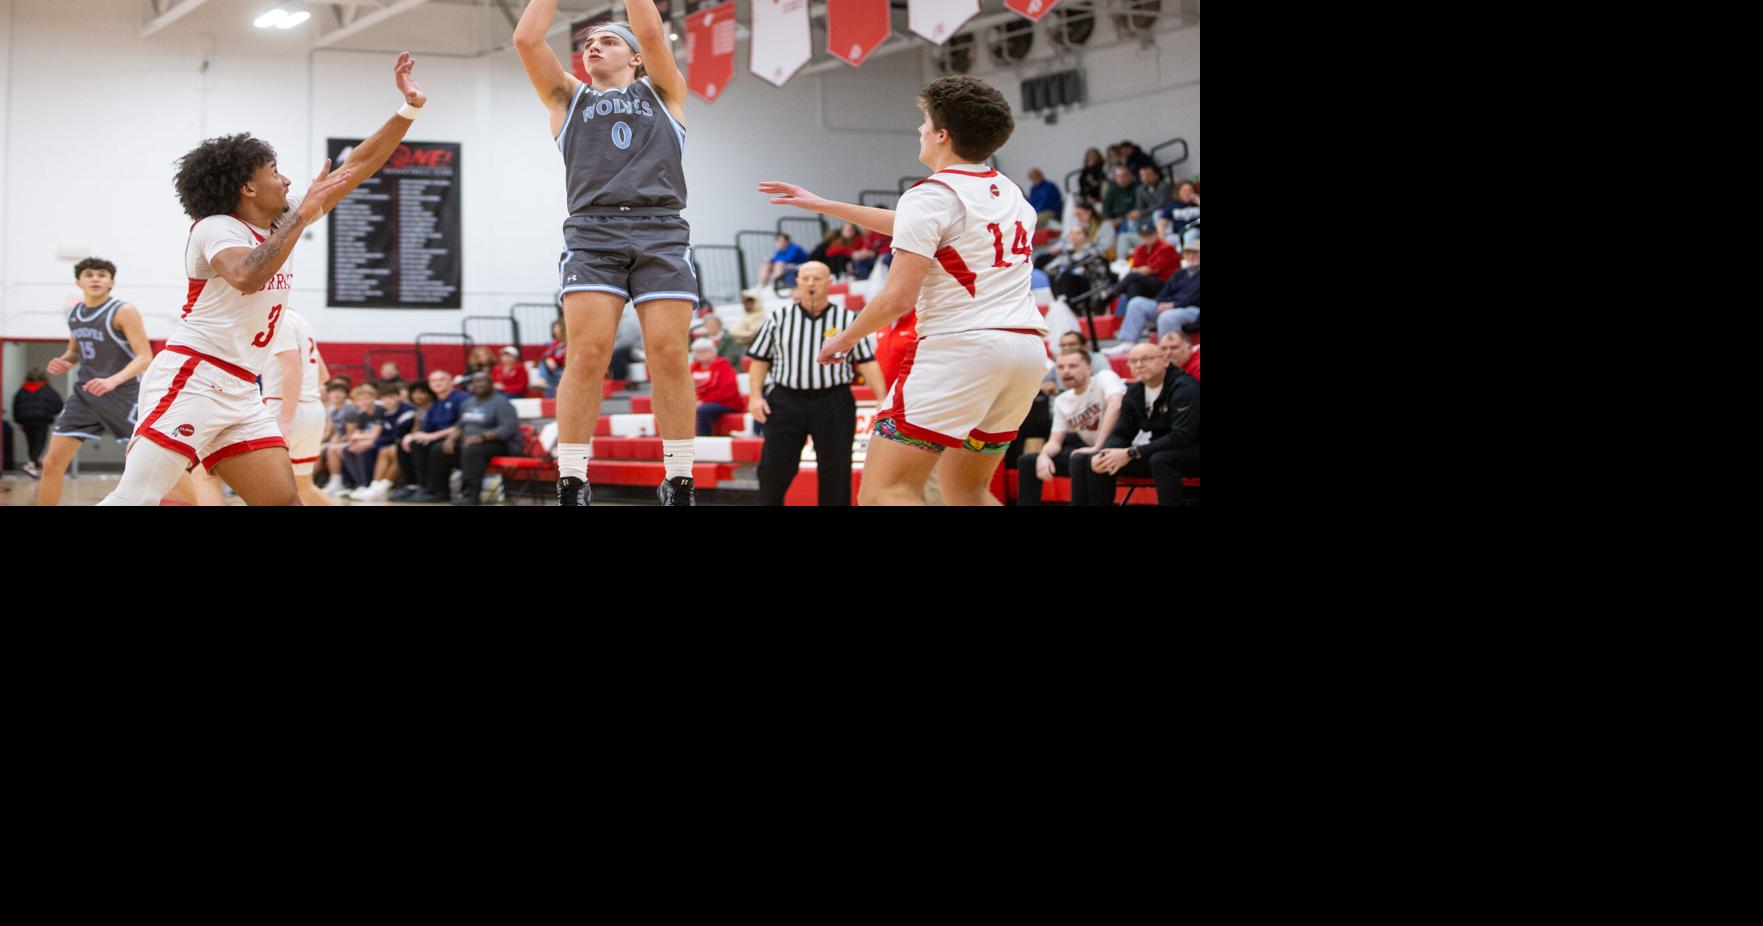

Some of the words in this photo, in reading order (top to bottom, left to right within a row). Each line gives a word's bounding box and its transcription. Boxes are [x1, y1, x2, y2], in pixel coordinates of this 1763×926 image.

[582, 98, 653, 122] WOLVES
[611, 121, 632, 150] 0
[986, 220, 1032, 267] 14
[251, 304, 282, 348] 3
[79, 341, 96, 360] 15
